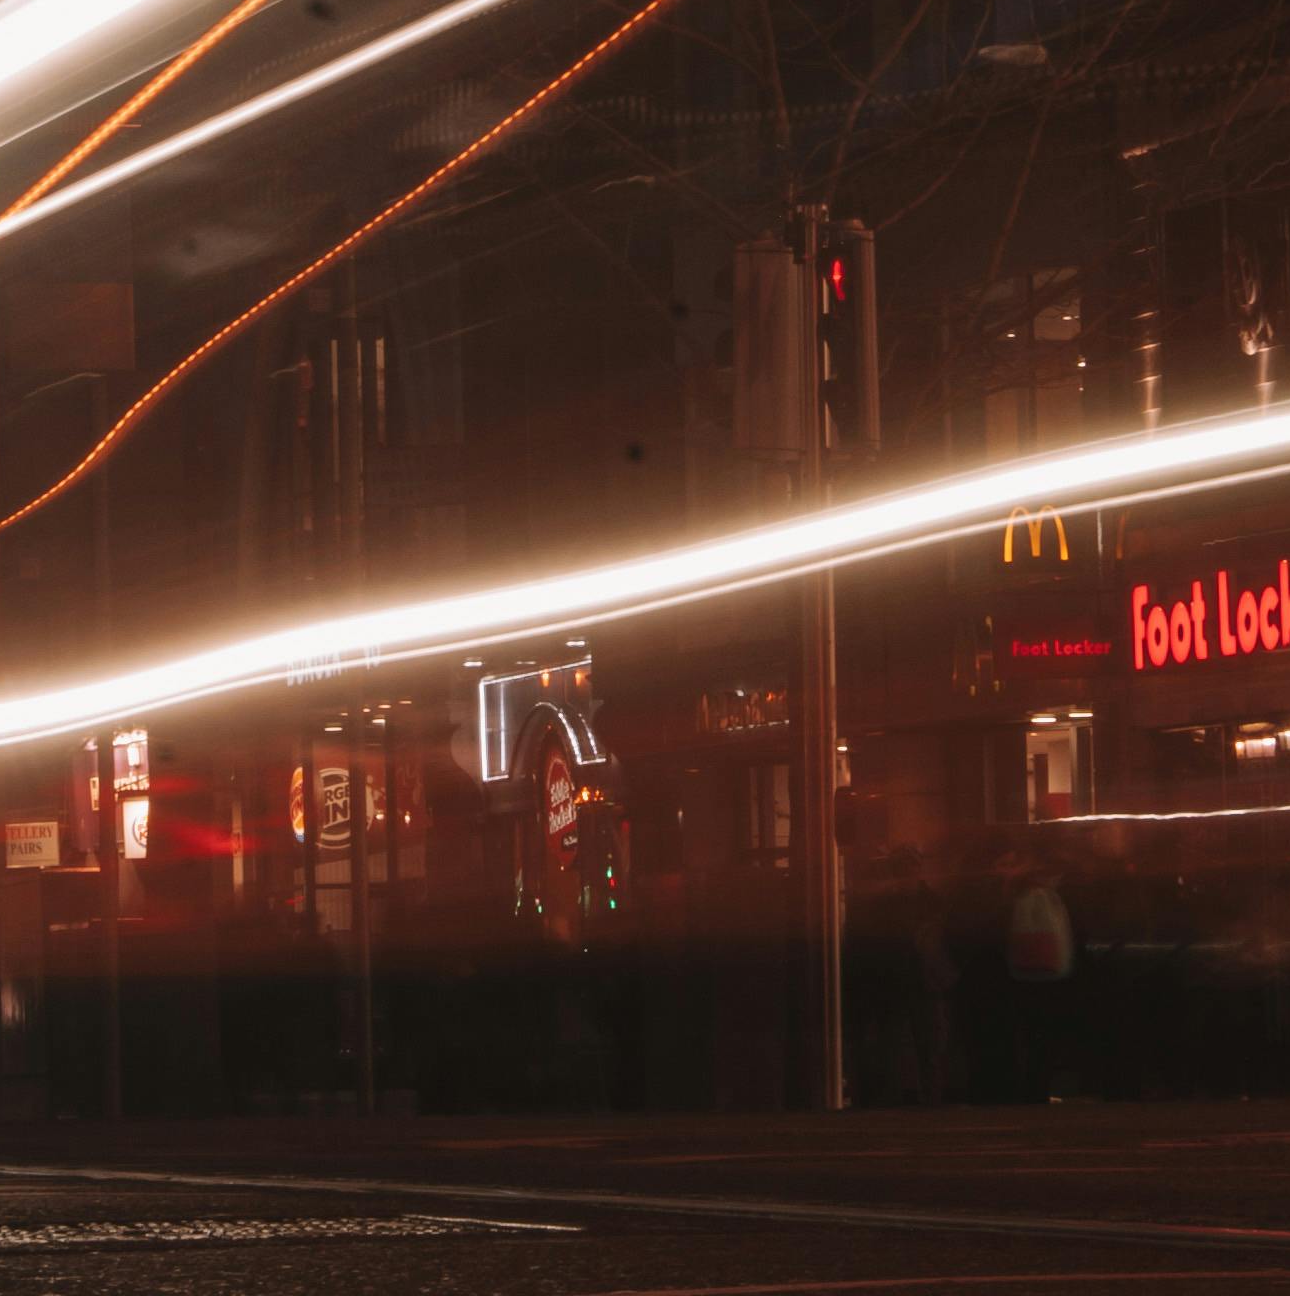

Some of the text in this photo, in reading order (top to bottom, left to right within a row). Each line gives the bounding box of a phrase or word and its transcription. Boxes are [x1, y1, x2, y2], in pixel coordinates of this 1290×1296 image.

[1133, 581, 1208, 670] Foot
[1012, 639, 1111, 657] Foot Locker
[10, 825, 54, 840] ELLERY
[10, 841, 43, 855] PAIRS
